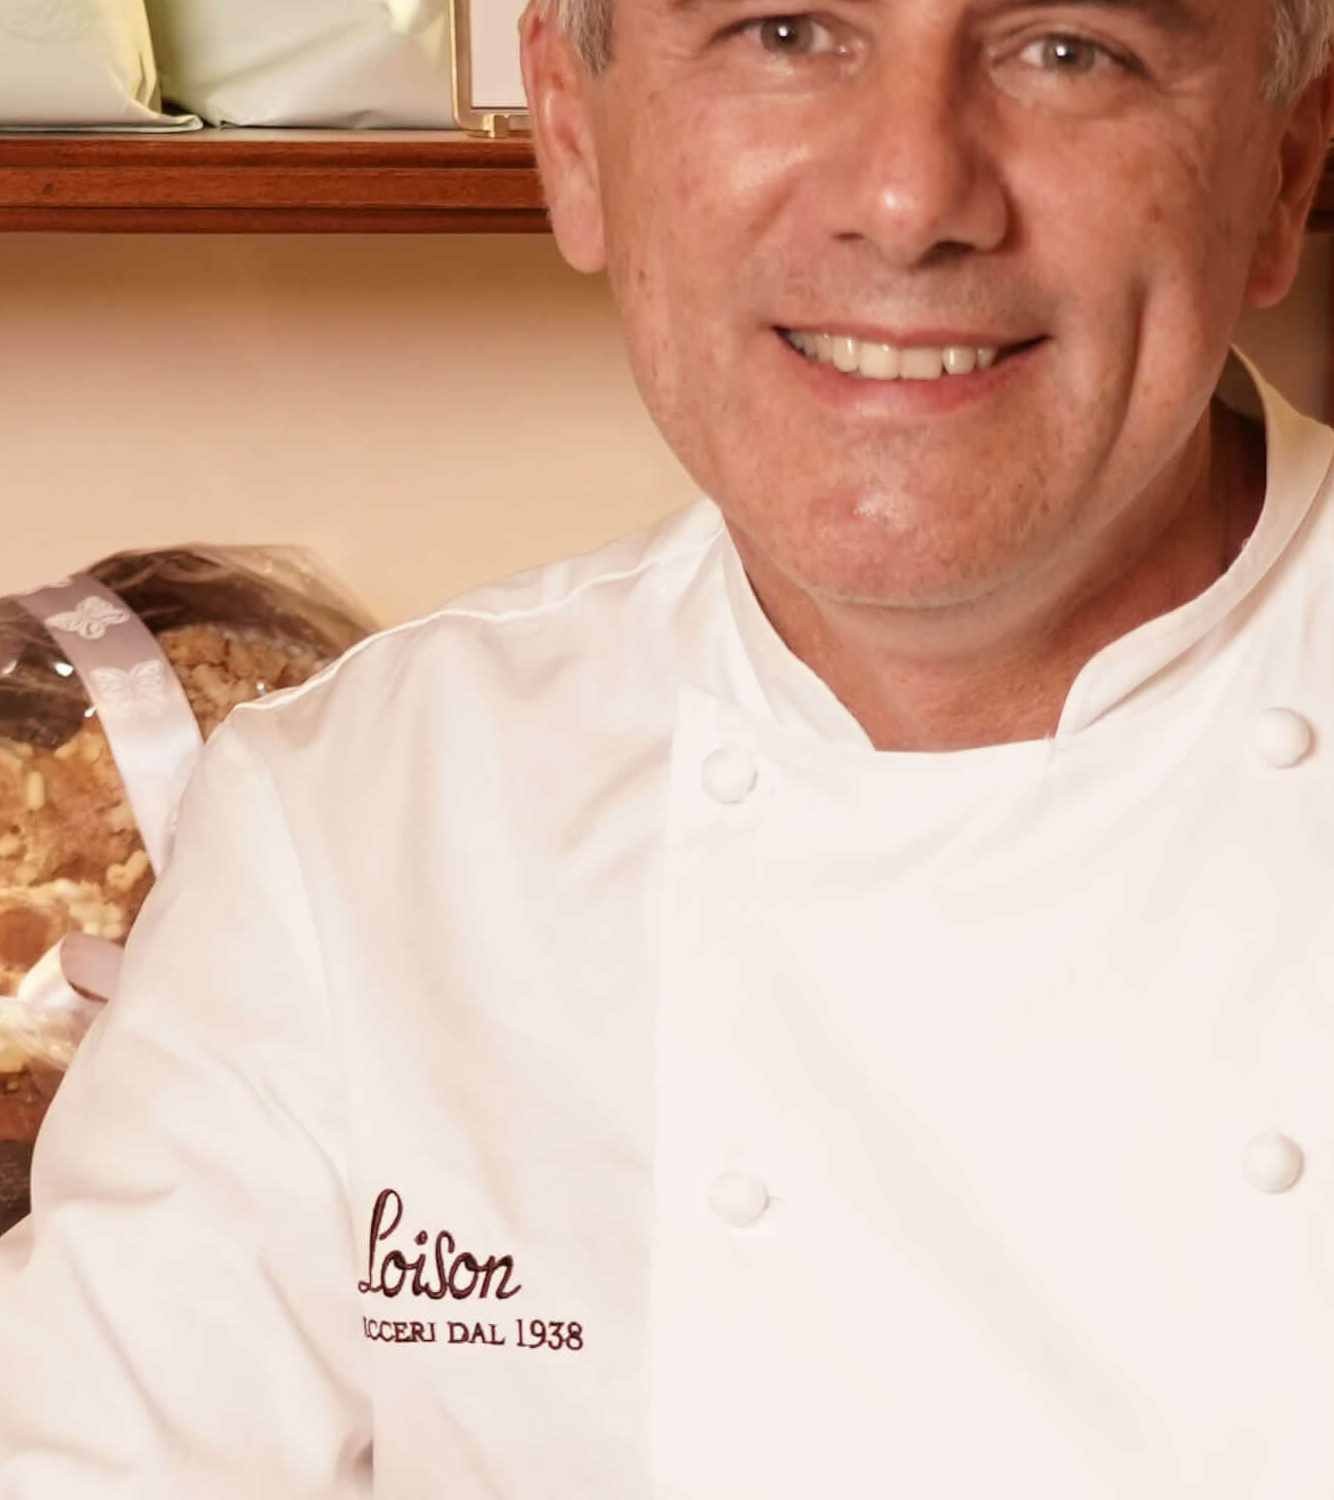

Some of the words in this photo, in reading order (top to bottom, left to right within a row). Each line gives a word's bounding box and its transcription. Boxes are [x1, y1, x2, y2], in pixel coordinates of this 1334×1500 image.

[357, 1188, 522, 1300] Loison
[447, 1321, 505, 1345] DAL
[516, 1318, 584, 1350] 1938
